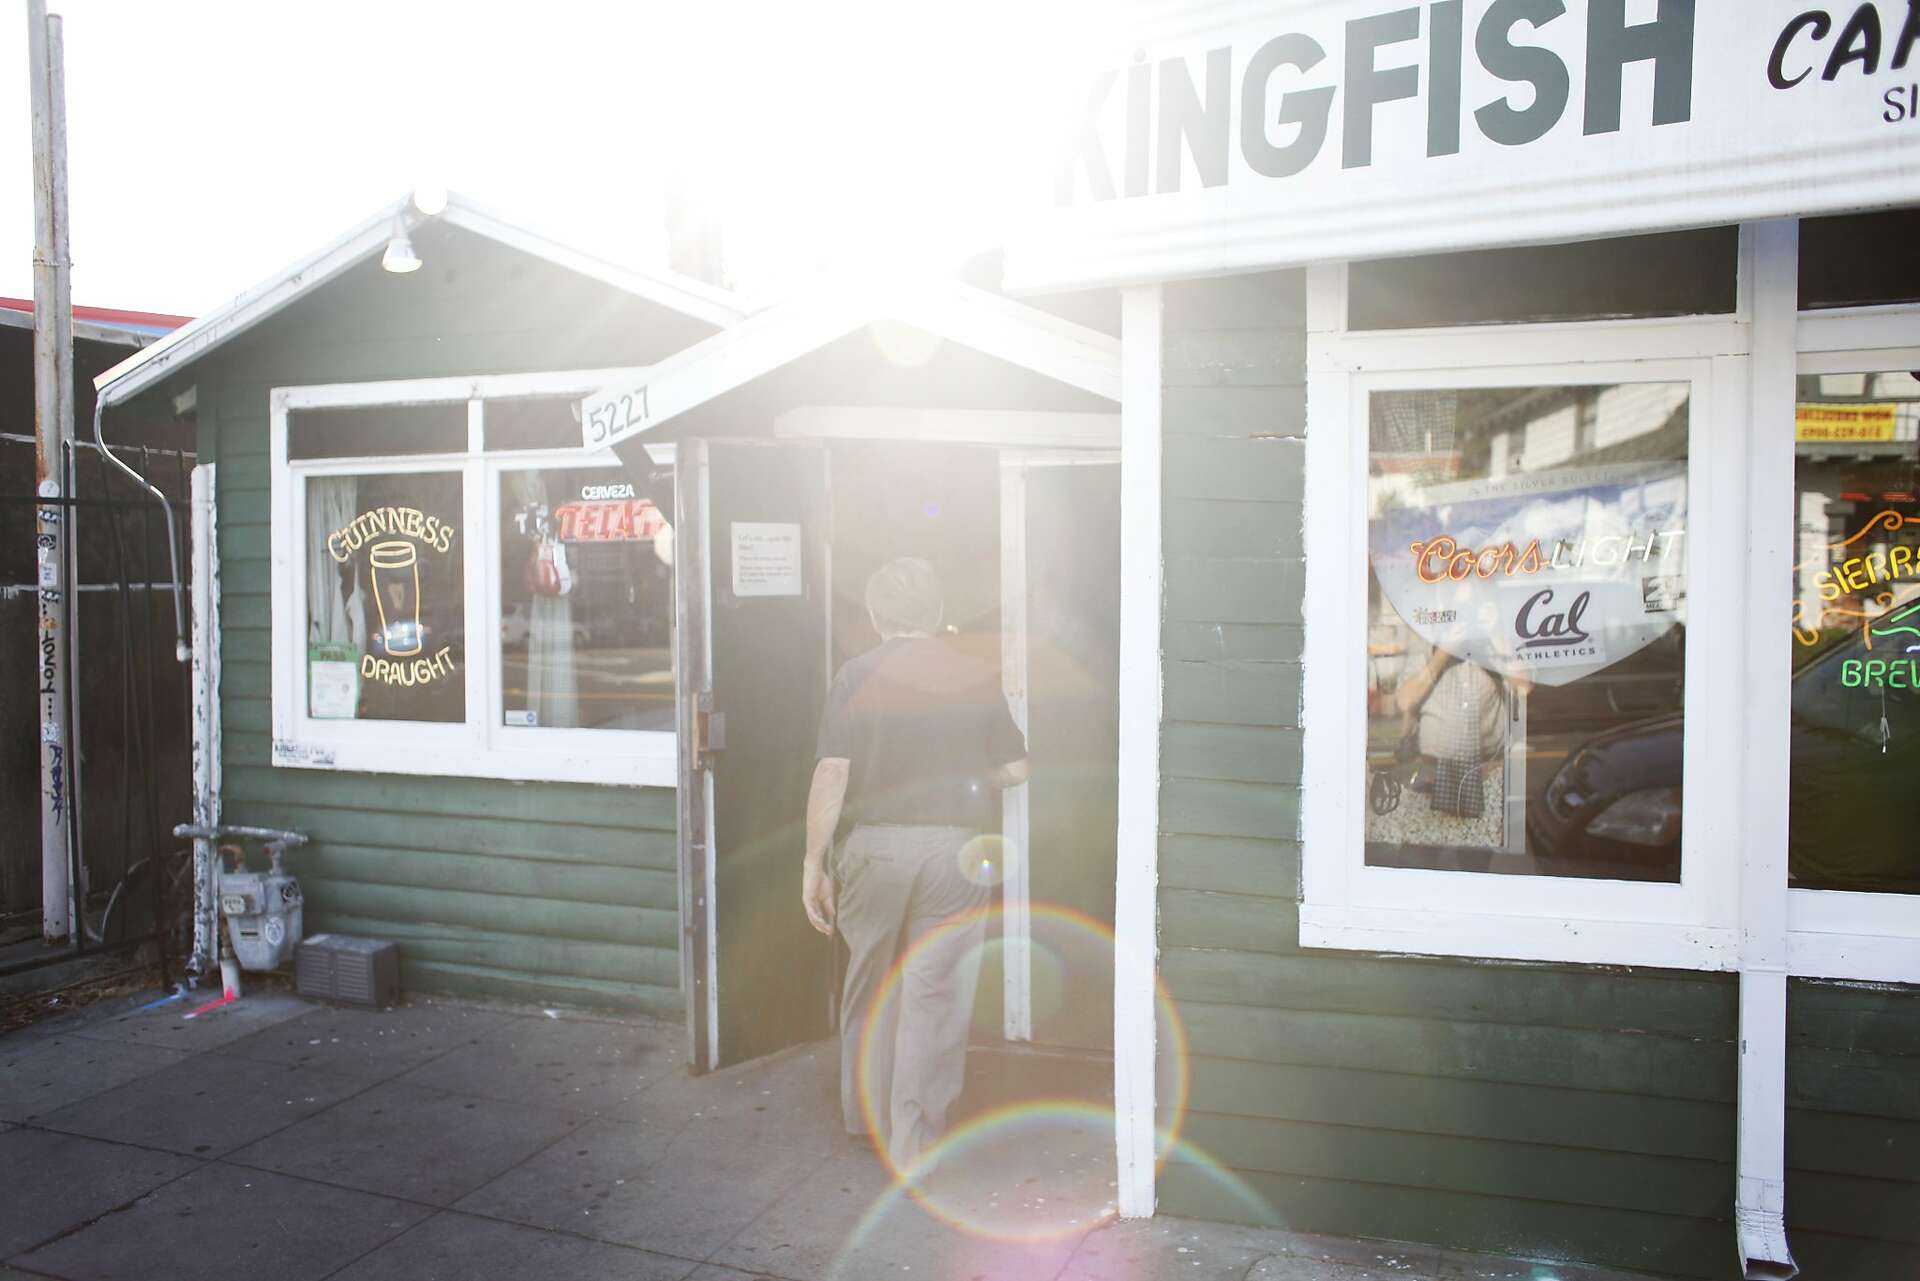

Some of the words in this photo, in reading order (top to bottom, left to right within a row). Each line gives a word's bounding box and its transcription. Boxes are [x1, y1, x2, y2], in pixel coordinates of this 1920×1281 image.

[1050, 0, 1693, 206] KINGFISH
[589, 384, 649, 443] 5227
[581, 484, 635, 500] CERVEZA
[327, 507, 455, 563] GUINNESS
[1410, 534, 1550, 585] Coors
[1551, 529, 1686, 569] LIGHT
[1515, 588, 1591, 647] Cal
[361, 646, 455, 687] DRAUGHT
[1516, 647, 1597, 662] ATHLETICS
